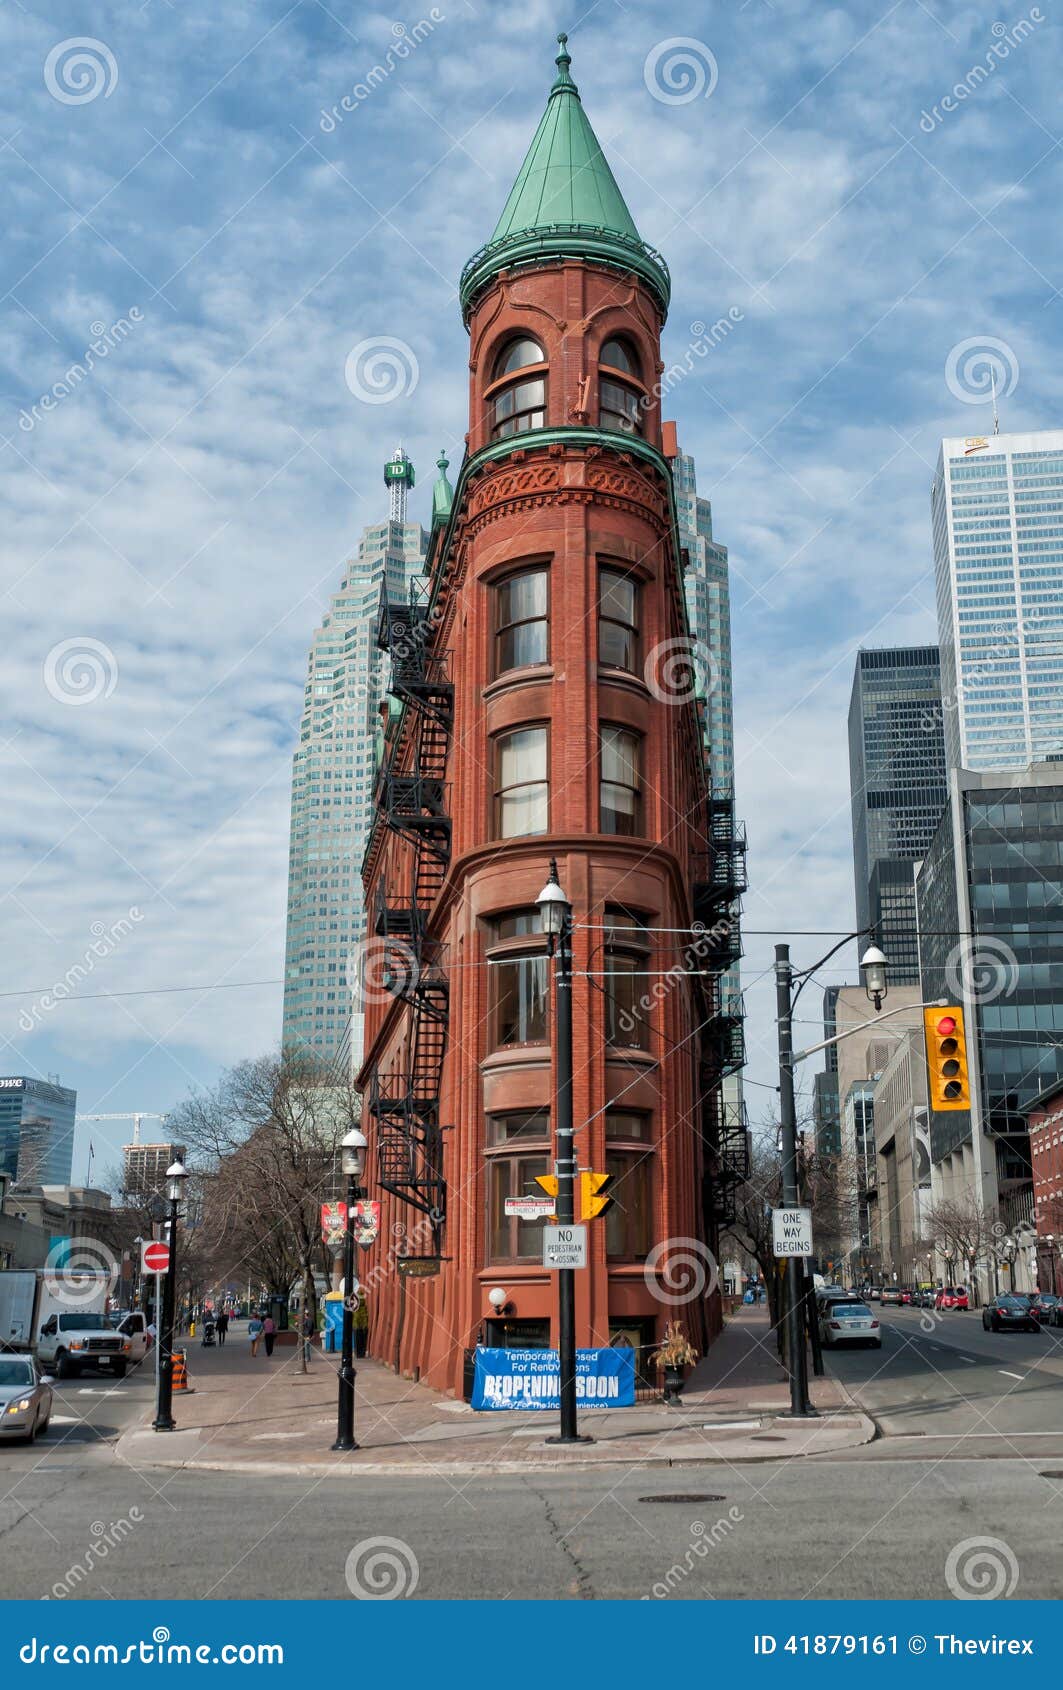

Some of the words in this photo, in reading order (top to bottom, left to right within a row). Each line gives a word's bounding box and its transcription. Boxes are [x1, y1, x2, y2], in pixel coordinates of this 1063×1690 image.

[386, 464, 403, 474] TD
[782, 1213, 801, 1224] ONE
[558, 1230, 573, 1242] NO
[783, 1227, 801, 1238] WAY
[547, 1244, 582, 1253] PEDESTRIAN
[776, 1241, 810, 1252] BEGINS
[550, 1254, 580, 1264] OSSING
[512, 1363, 527, 1372] For
[530, 1363, 590, 1372] Renovons
[575, 1375, 619, 1398] SOON
